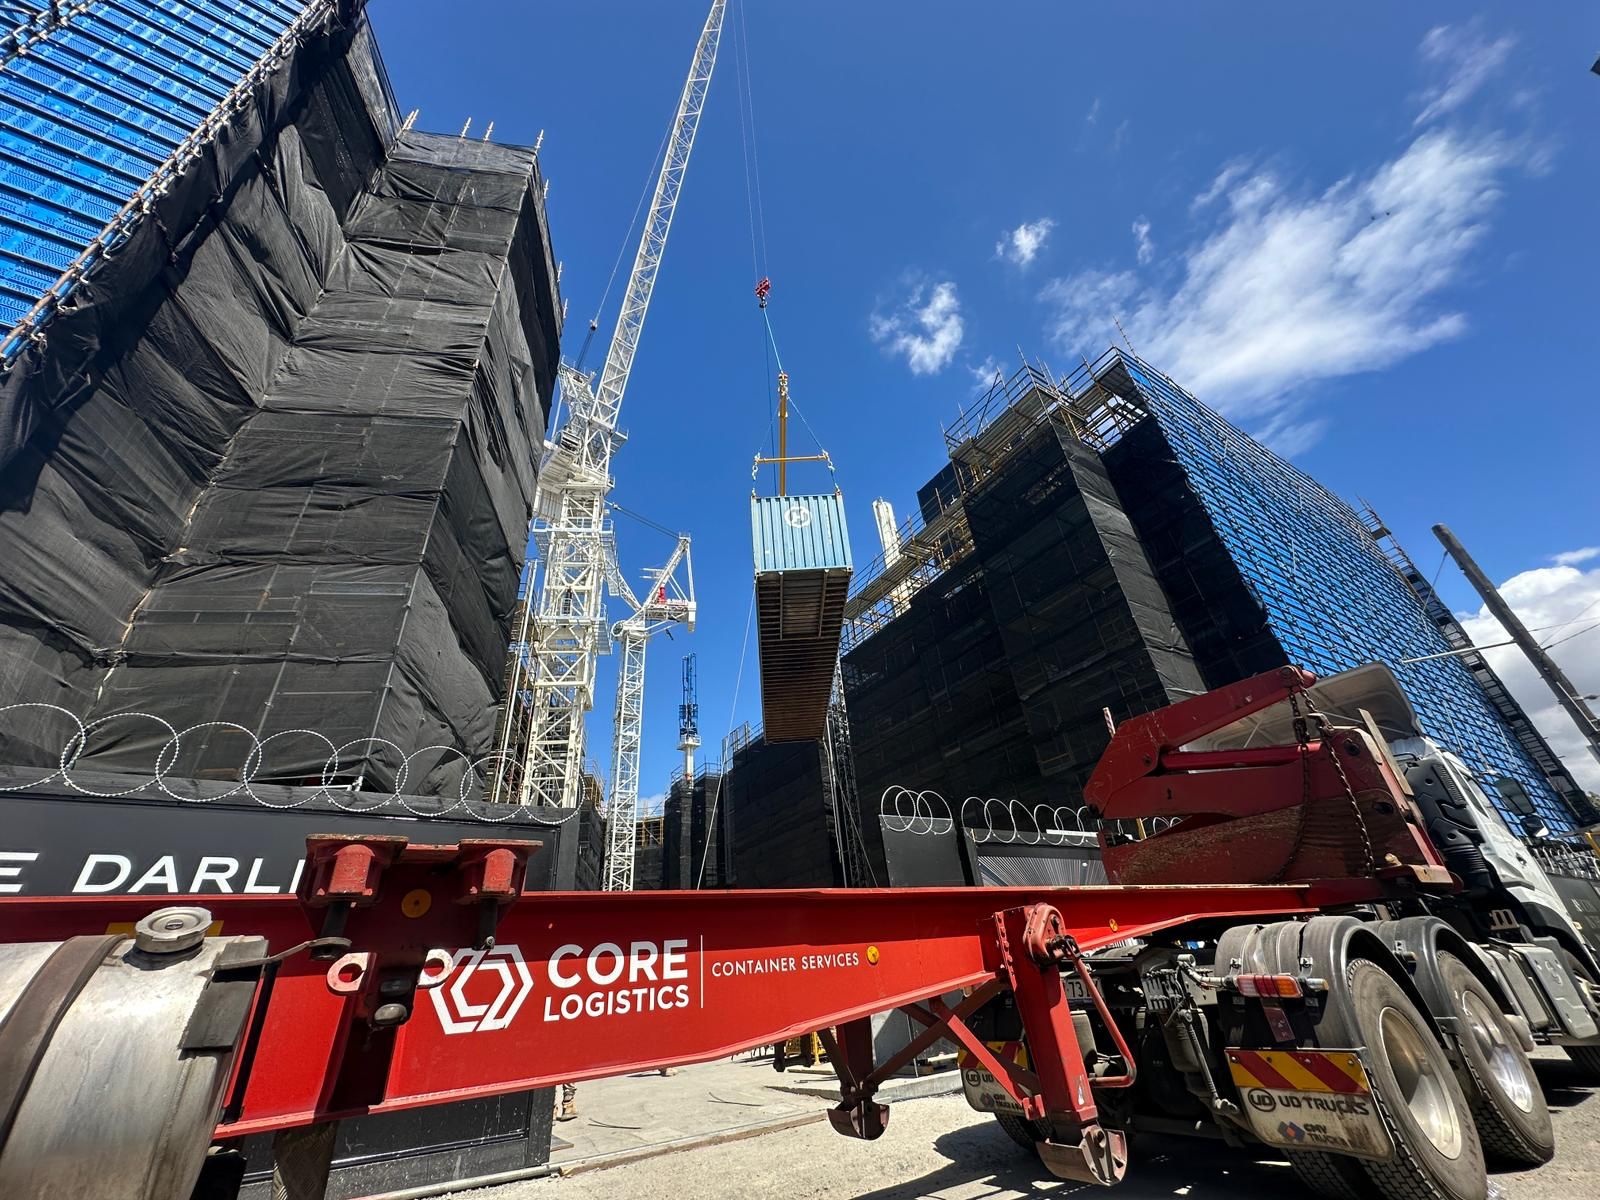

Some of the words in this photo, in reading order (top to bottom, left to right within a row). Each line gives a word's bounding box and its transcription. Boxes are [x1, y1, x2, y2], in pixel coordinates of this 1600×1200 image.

[547, 939, 689, 989] CORE
[711, 957, 797, 977] CONTAINER
[801, 952, 860, 970] SERVICES
[543, 984, 690, 1022] LOGISTICS
[1277, 1095, 1302, 1108] UD
[1302, 1096, 1370, 1116] TRUCKS
